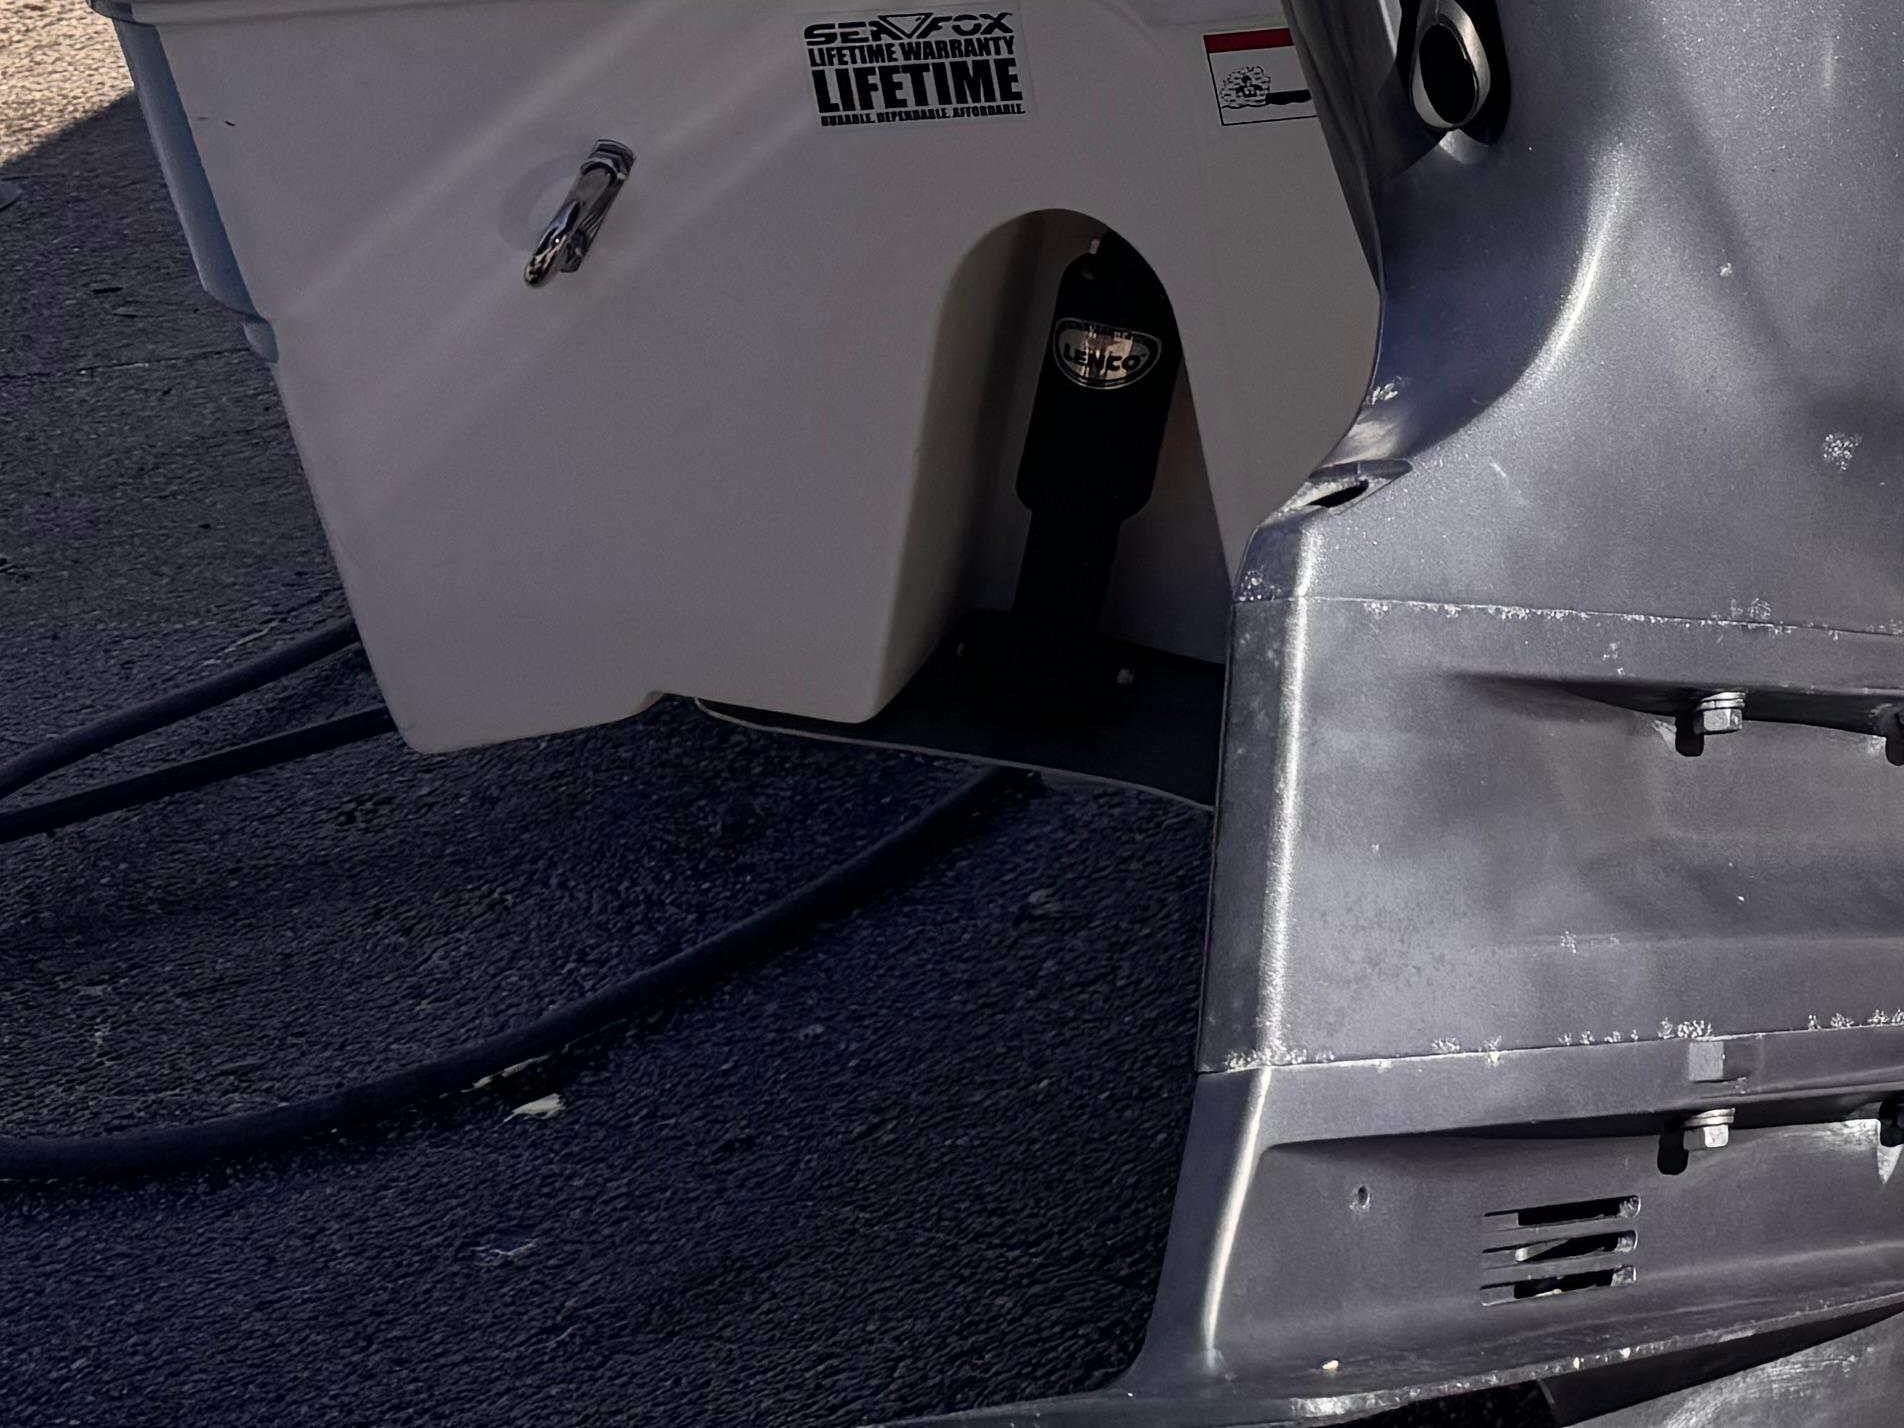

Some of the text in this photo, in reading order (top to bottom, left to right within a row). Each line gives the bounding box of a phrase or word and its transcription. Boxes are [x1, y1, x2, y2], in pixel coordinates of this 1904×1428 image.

[808, 35, 1015, 67] LIFETIME WARRANTY
[811, 58, 1024, 114] LIFETIME
[1063, 343, 1142, 374] LENCO
